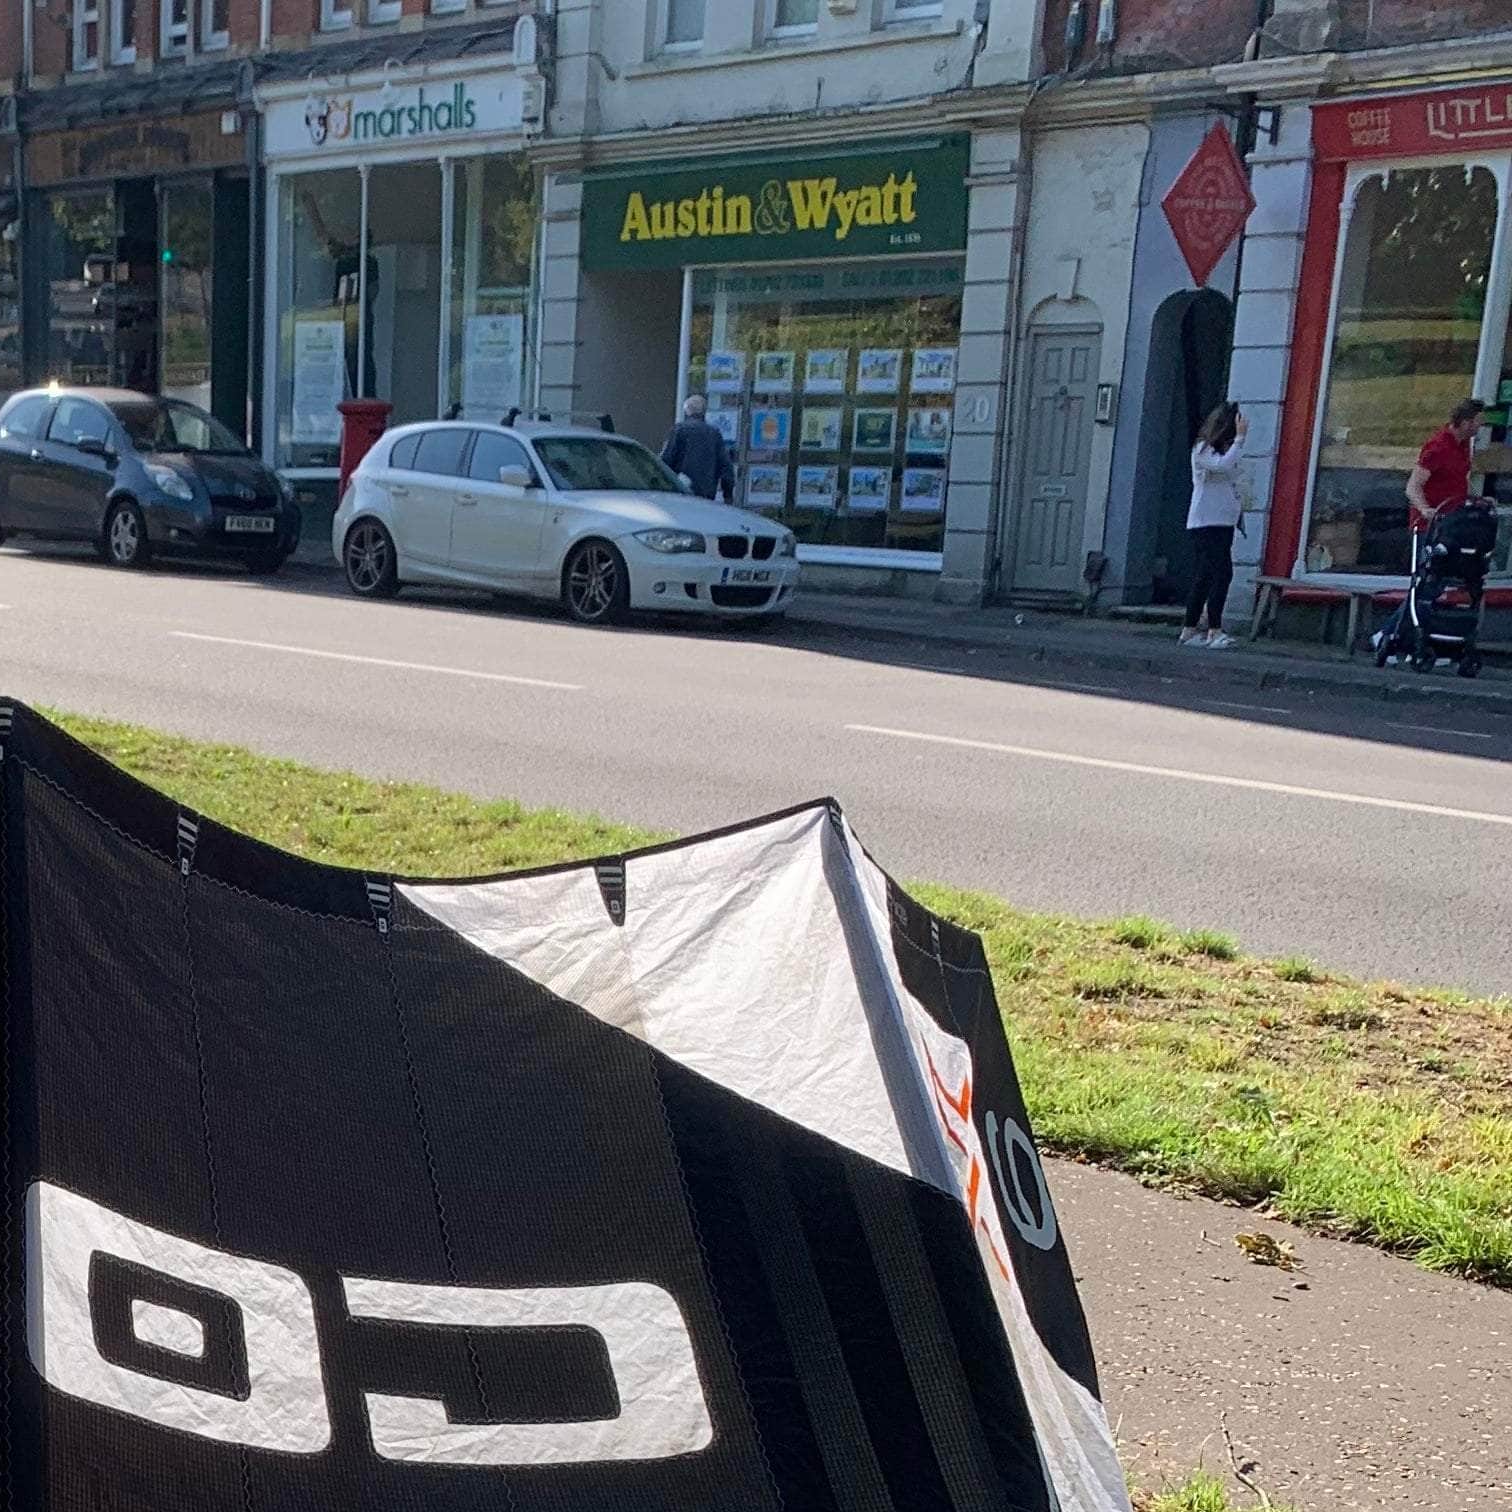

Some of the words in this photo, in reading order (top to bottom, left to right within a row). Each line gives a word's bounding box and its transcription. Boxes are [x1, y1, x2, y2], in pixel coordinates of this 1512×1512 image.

[353, 81, 477, 140] marshalls
[1348, 108, 1391, 129] COFFEE
[1350, 127, 1391, 146] HOUSE
[620, 184, 753, 242] Austin
[754, 179, 789, 235] &
[787, 170, 917, 240] Wyatt
